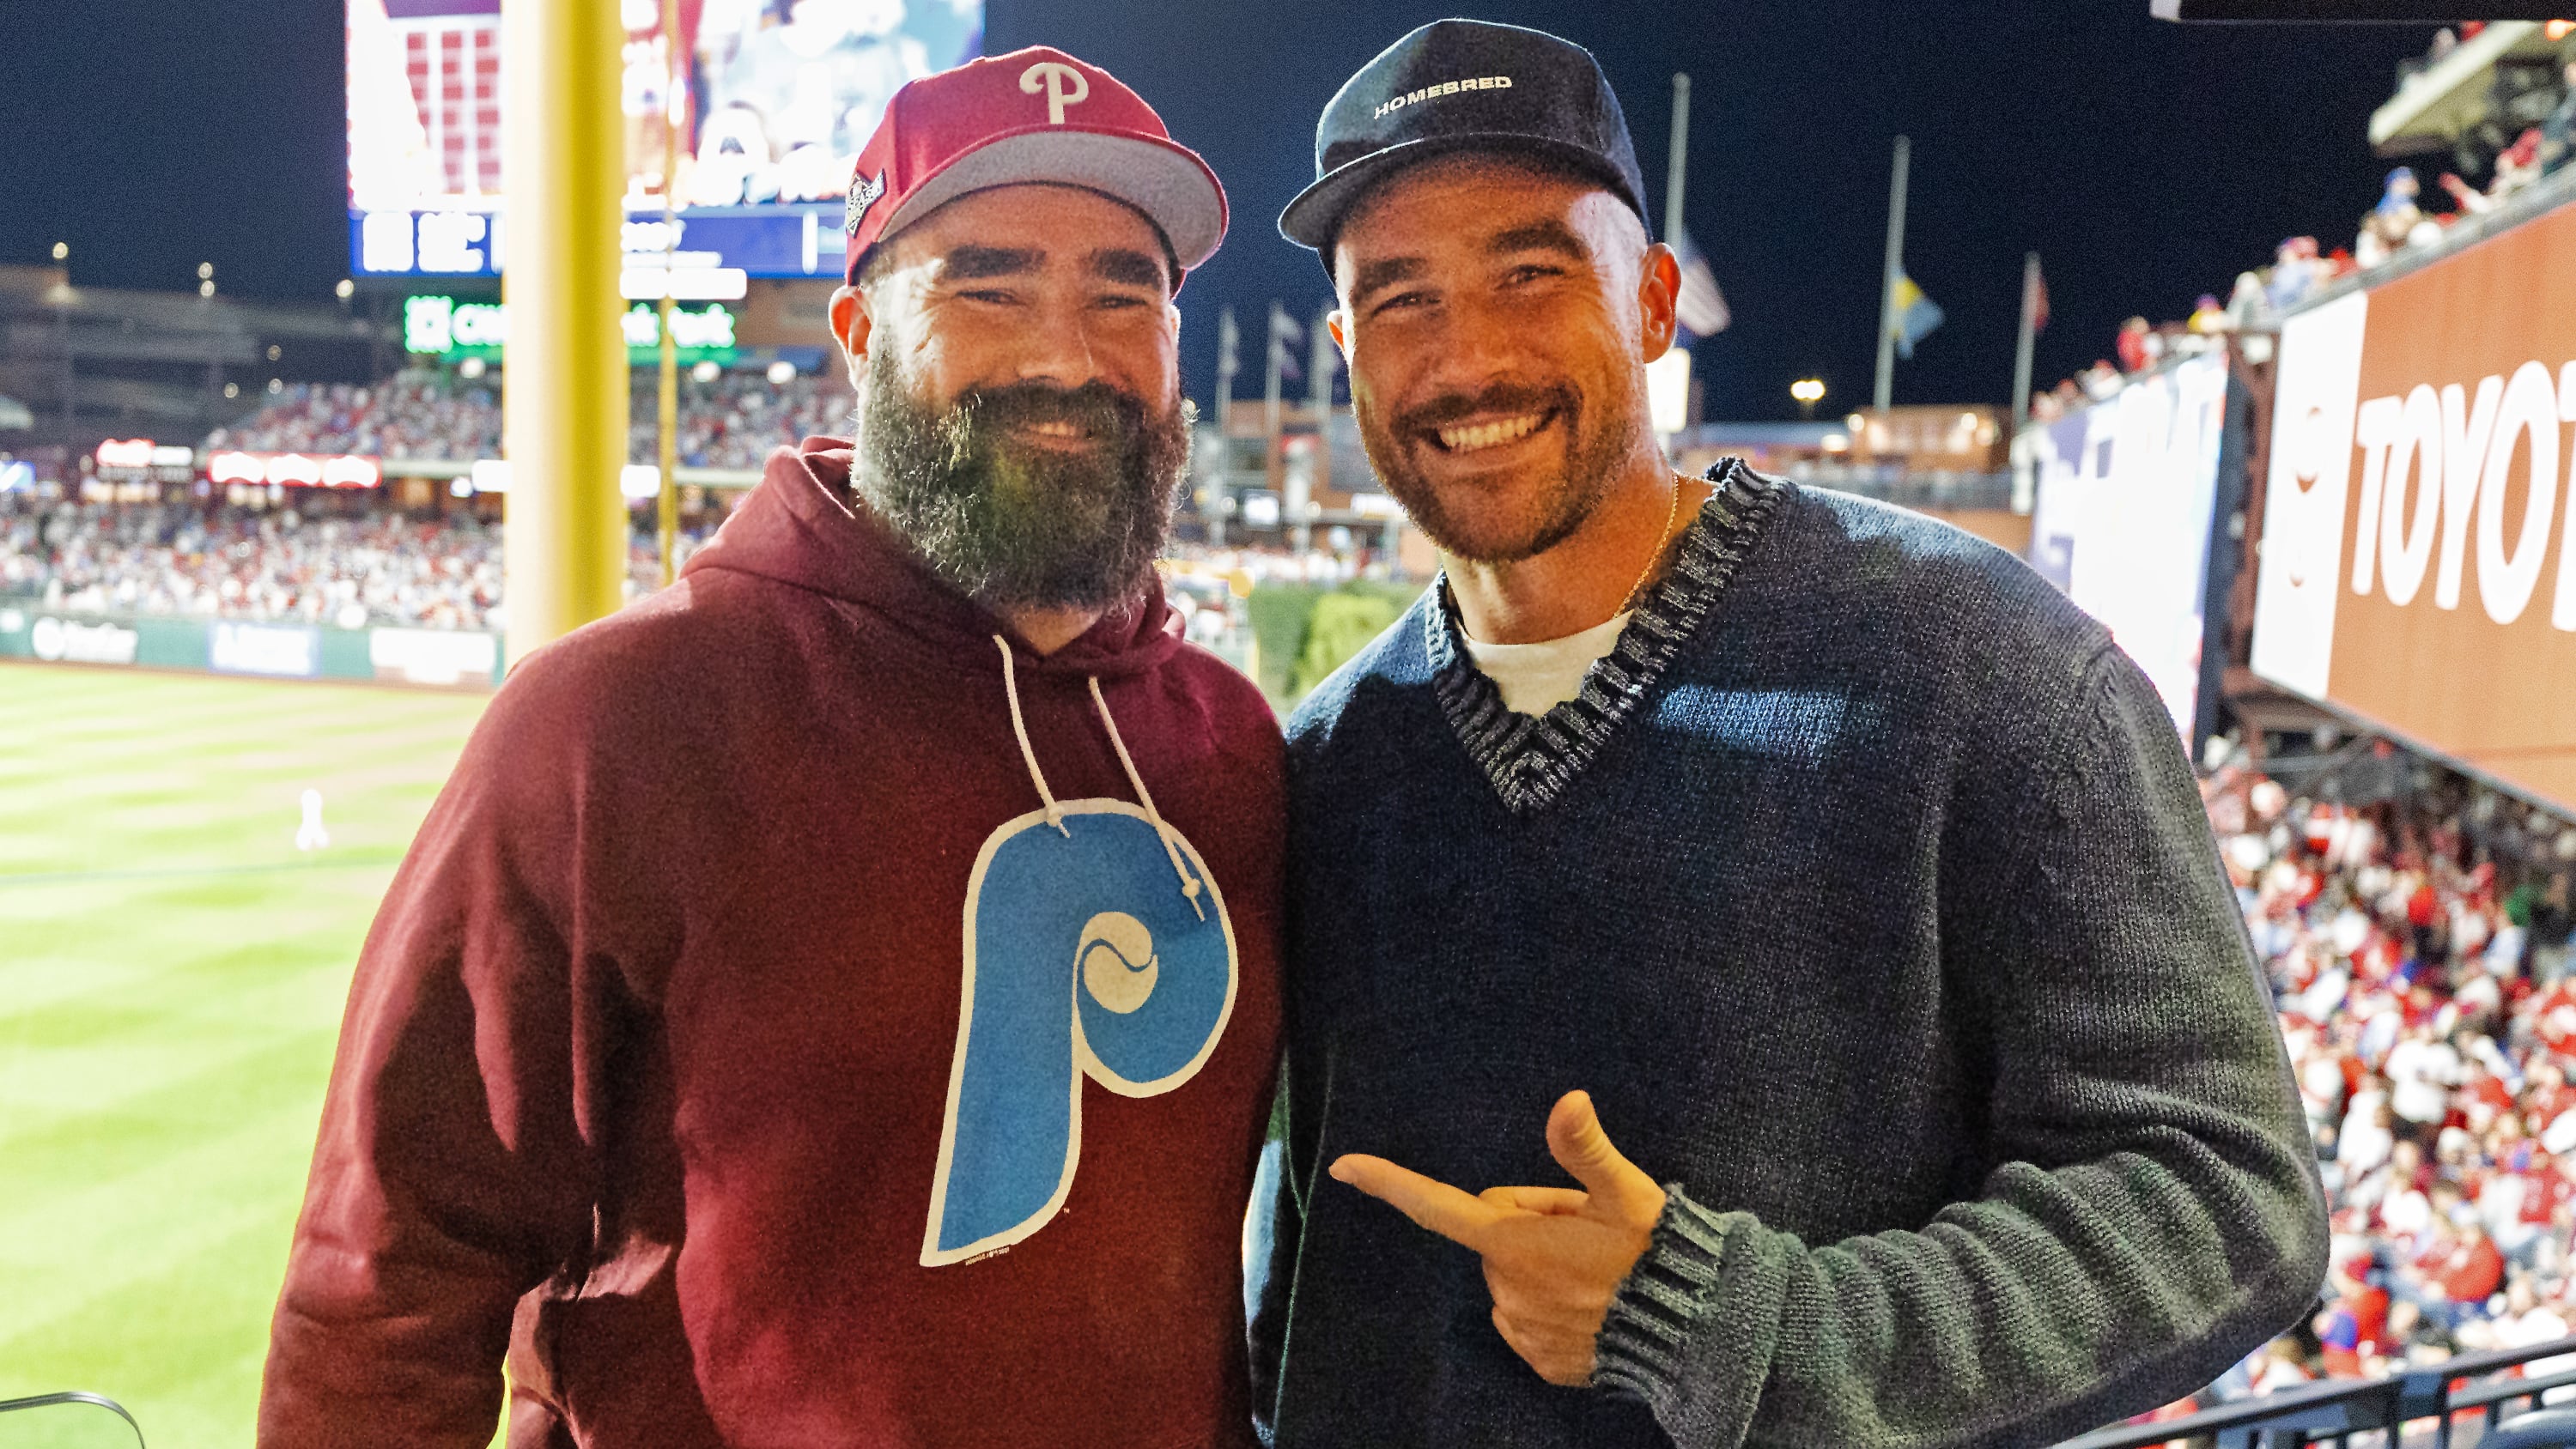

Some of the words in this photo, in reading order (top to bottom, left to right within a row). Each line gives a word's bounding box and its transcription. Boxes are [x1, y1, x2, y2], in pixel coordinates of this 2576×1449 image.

[1019, 62, 1090, 124] P
[1374, 76, 1513, 120] HOMEBRED
[920, 797, 1238, 1266] P
